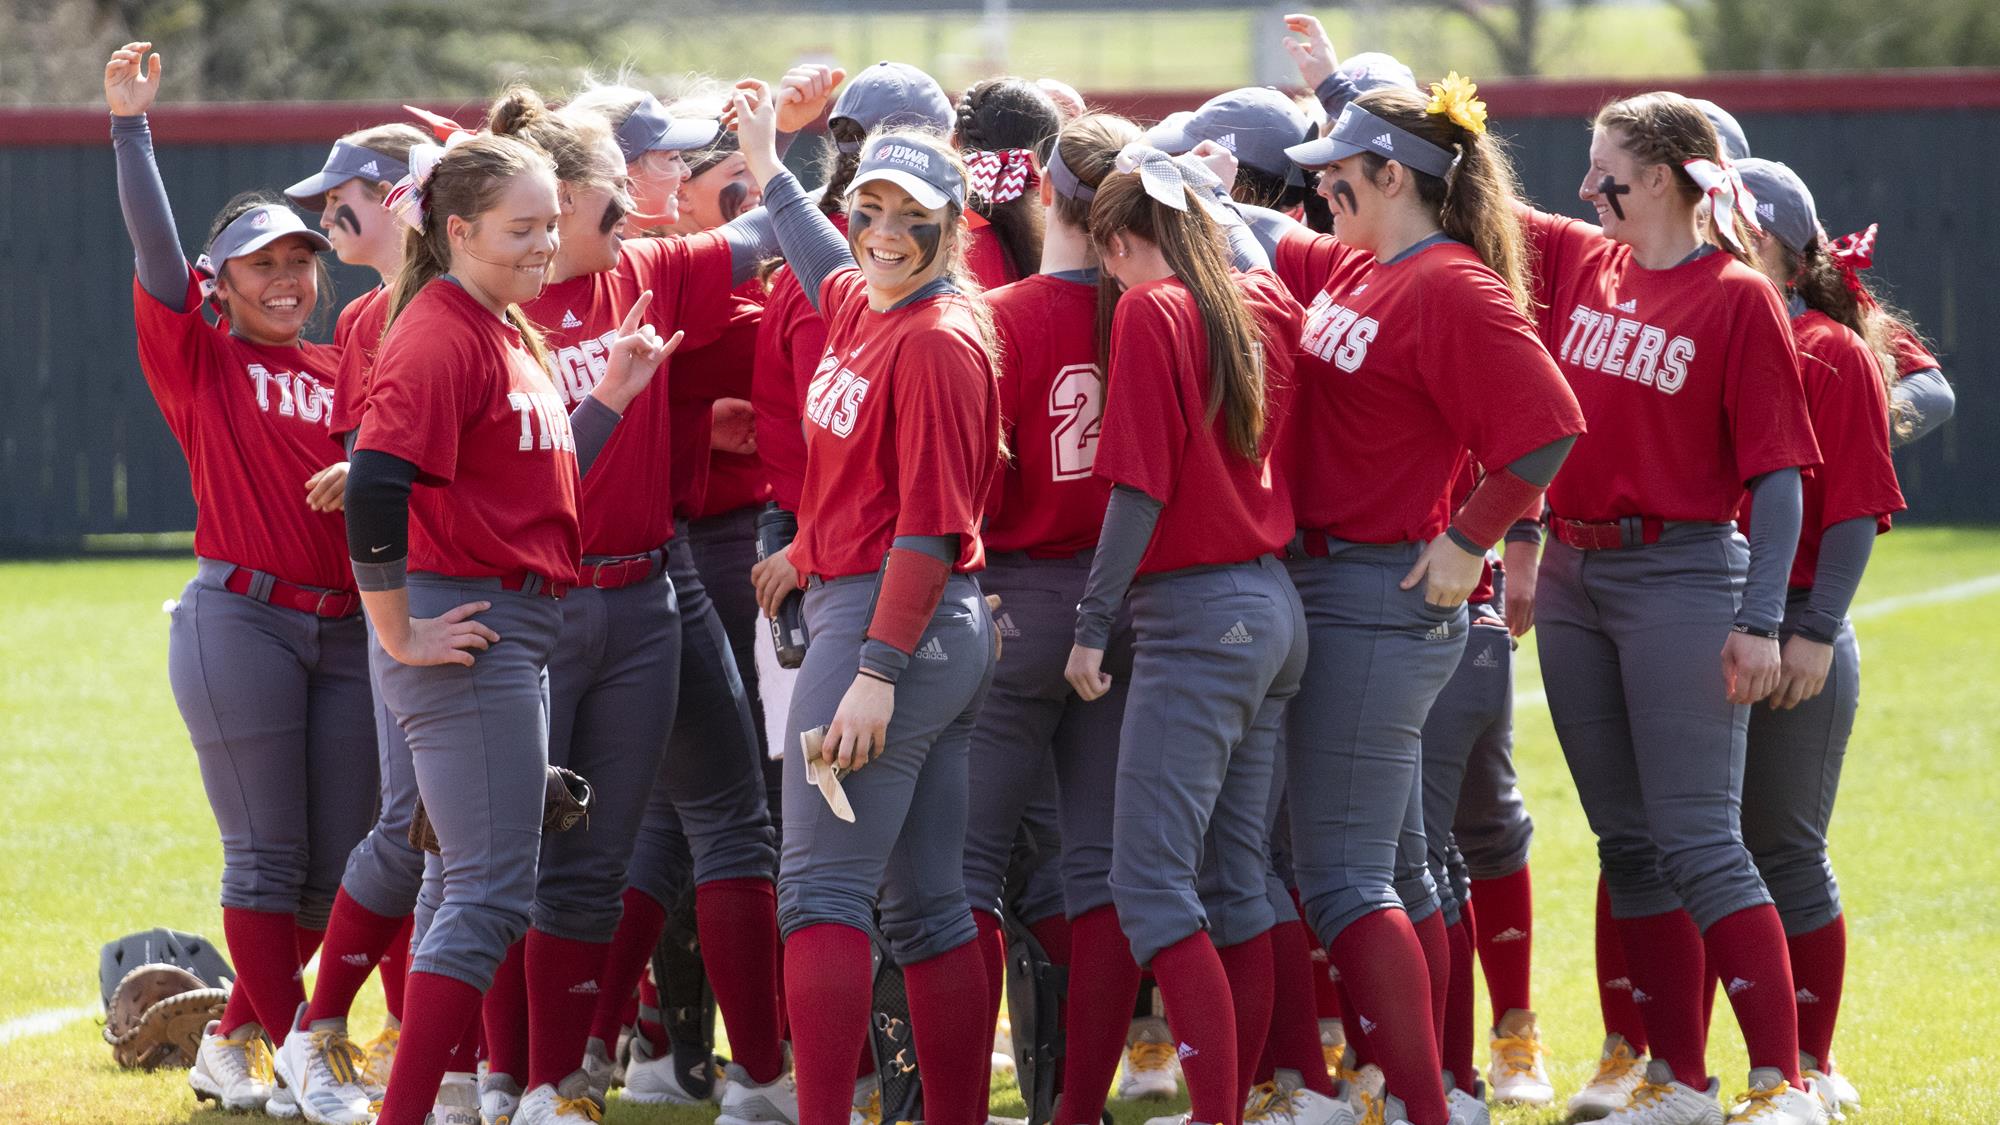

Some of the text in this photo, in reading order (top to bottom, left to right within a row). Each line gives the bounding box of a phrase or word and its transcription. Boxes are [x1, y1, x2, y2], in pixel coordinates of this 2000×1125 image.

[889, 157, 928, 174] SOFTBALL
[892, 145, 930, 168] UWA
[1560, 304, 1696, 394] TIGERS
[915, 650, 949, 661] adidas
